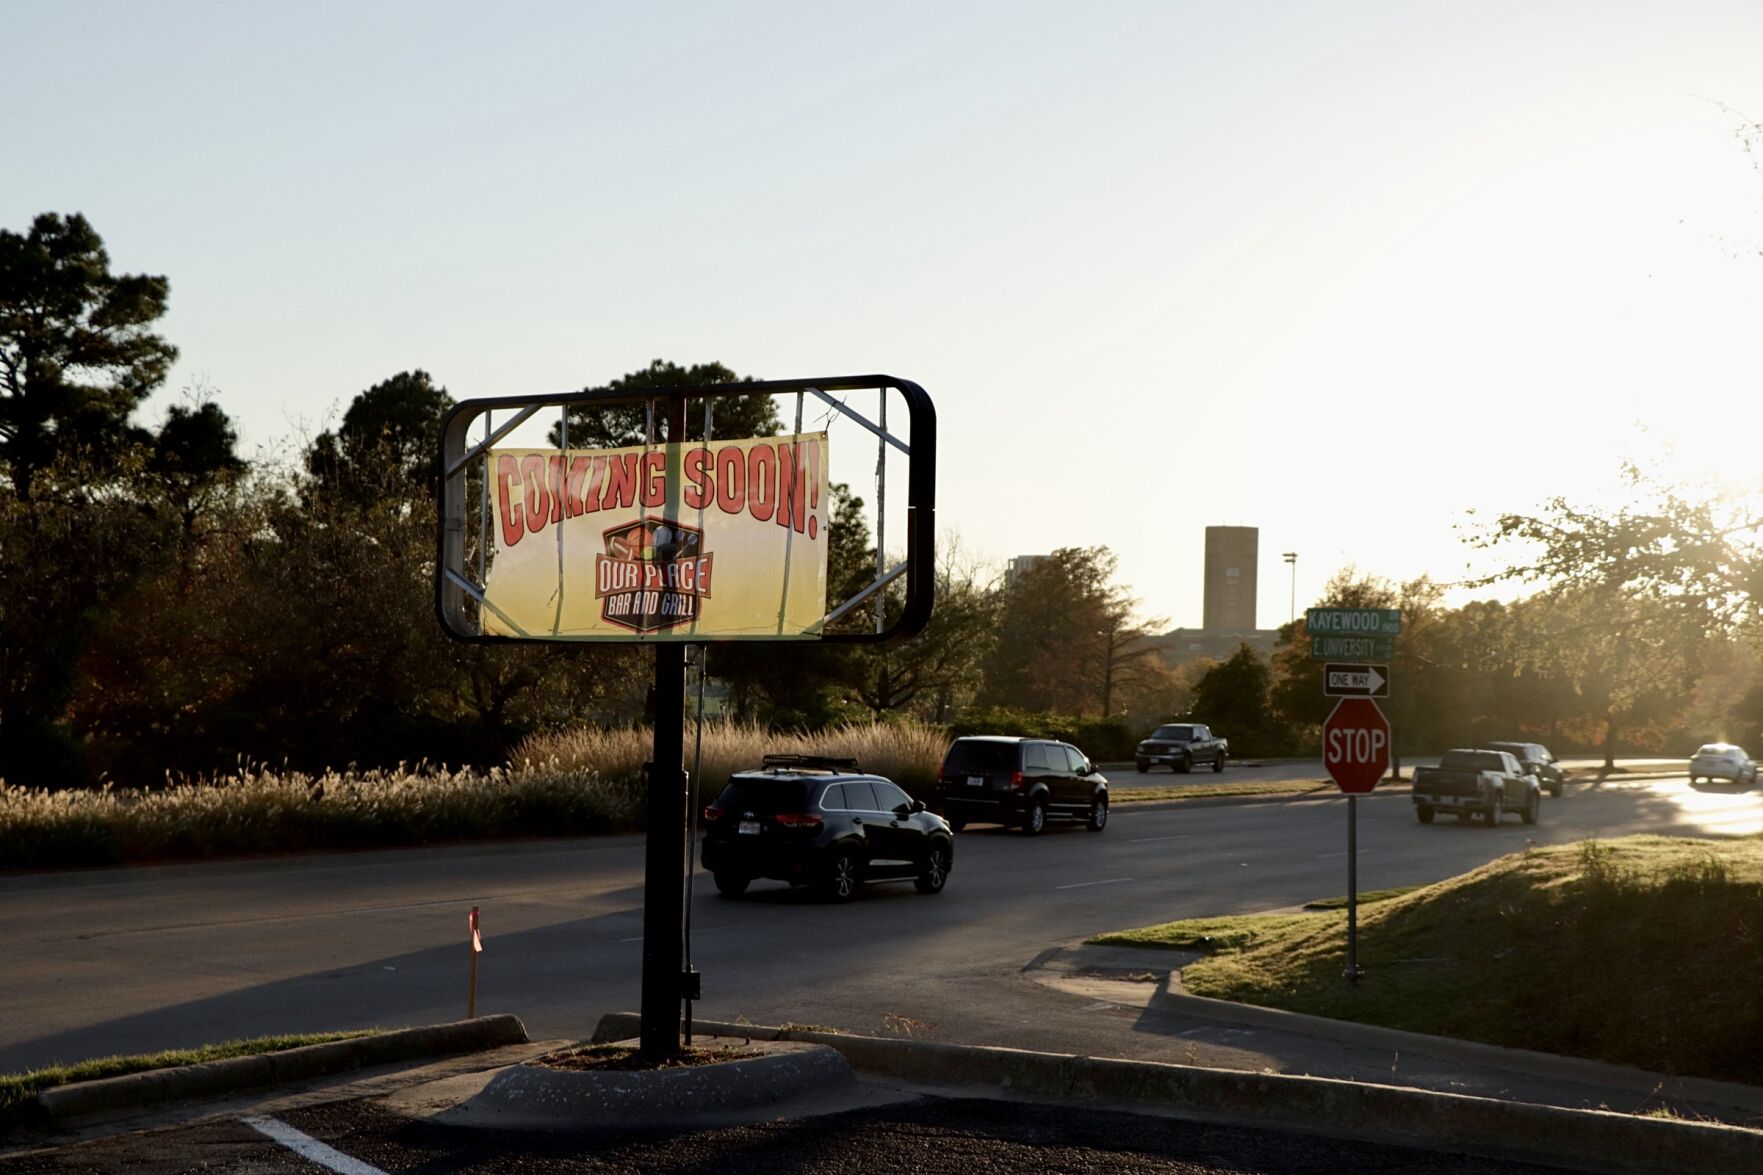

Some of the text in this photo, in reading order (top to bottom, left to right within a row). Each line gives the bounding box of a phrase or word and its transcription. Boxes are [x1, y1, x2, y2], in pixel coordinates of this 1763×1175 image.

[498, 439, 820, 547] COMING SOON!
[599, 558, 708, 592] OUR PLACE
[608, 591, 694, 616] BAR AND GRILL
[1308, 611, 1380, 630] KAYEWOOD
[1331, 673, 1369, 686] ONE WAY
[1328, 728, 1385, 764] STOP
